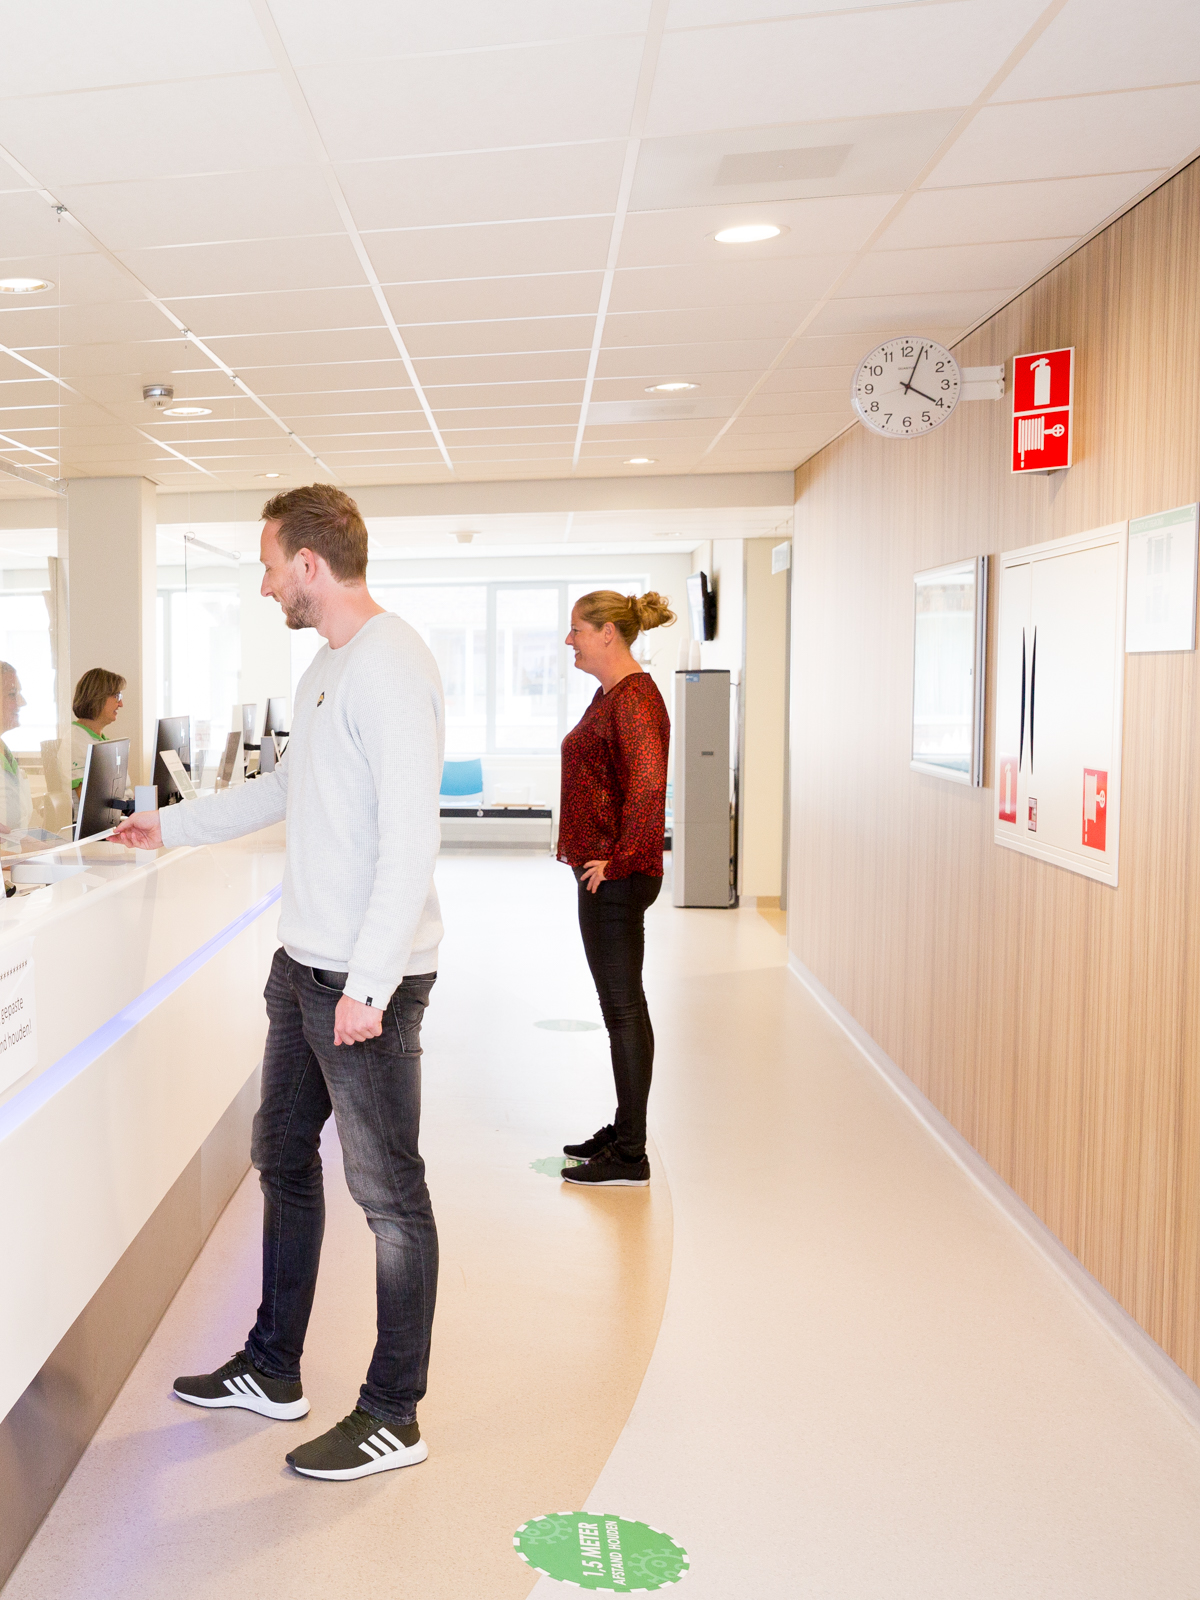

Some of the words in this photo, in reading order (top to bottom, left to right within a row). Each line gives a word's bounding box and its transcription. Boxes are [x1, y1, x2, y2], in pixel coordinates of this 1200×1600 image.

[883, 351, 893, 363] 11
[900, 346, 914, 358] 12
[924, 349, 929, 361] 1
[868, 365, 884, 377] 10
[935, 361, 945, 373] 2
[864, 383, 874, 395] 9
[940, 379, 951, 391] 3
[870, 401, 880, 412] 8
[934, 397, 945, 408] 4
[883, 413, 893, 425] 7
[902, 416, 912, 428] 6
[921, 411, 931, 423] 5
[1, 997, 24, 1025] gepaste
[7, 1017, 33, 1048] houden!
[577, 1522, 602, 1559] METER
[604, 1520, 622, 1551] HOUDEN
[581, 1560, 607, 1577] 1,5
[609, 1551, 627, 1586] AFSTAND
